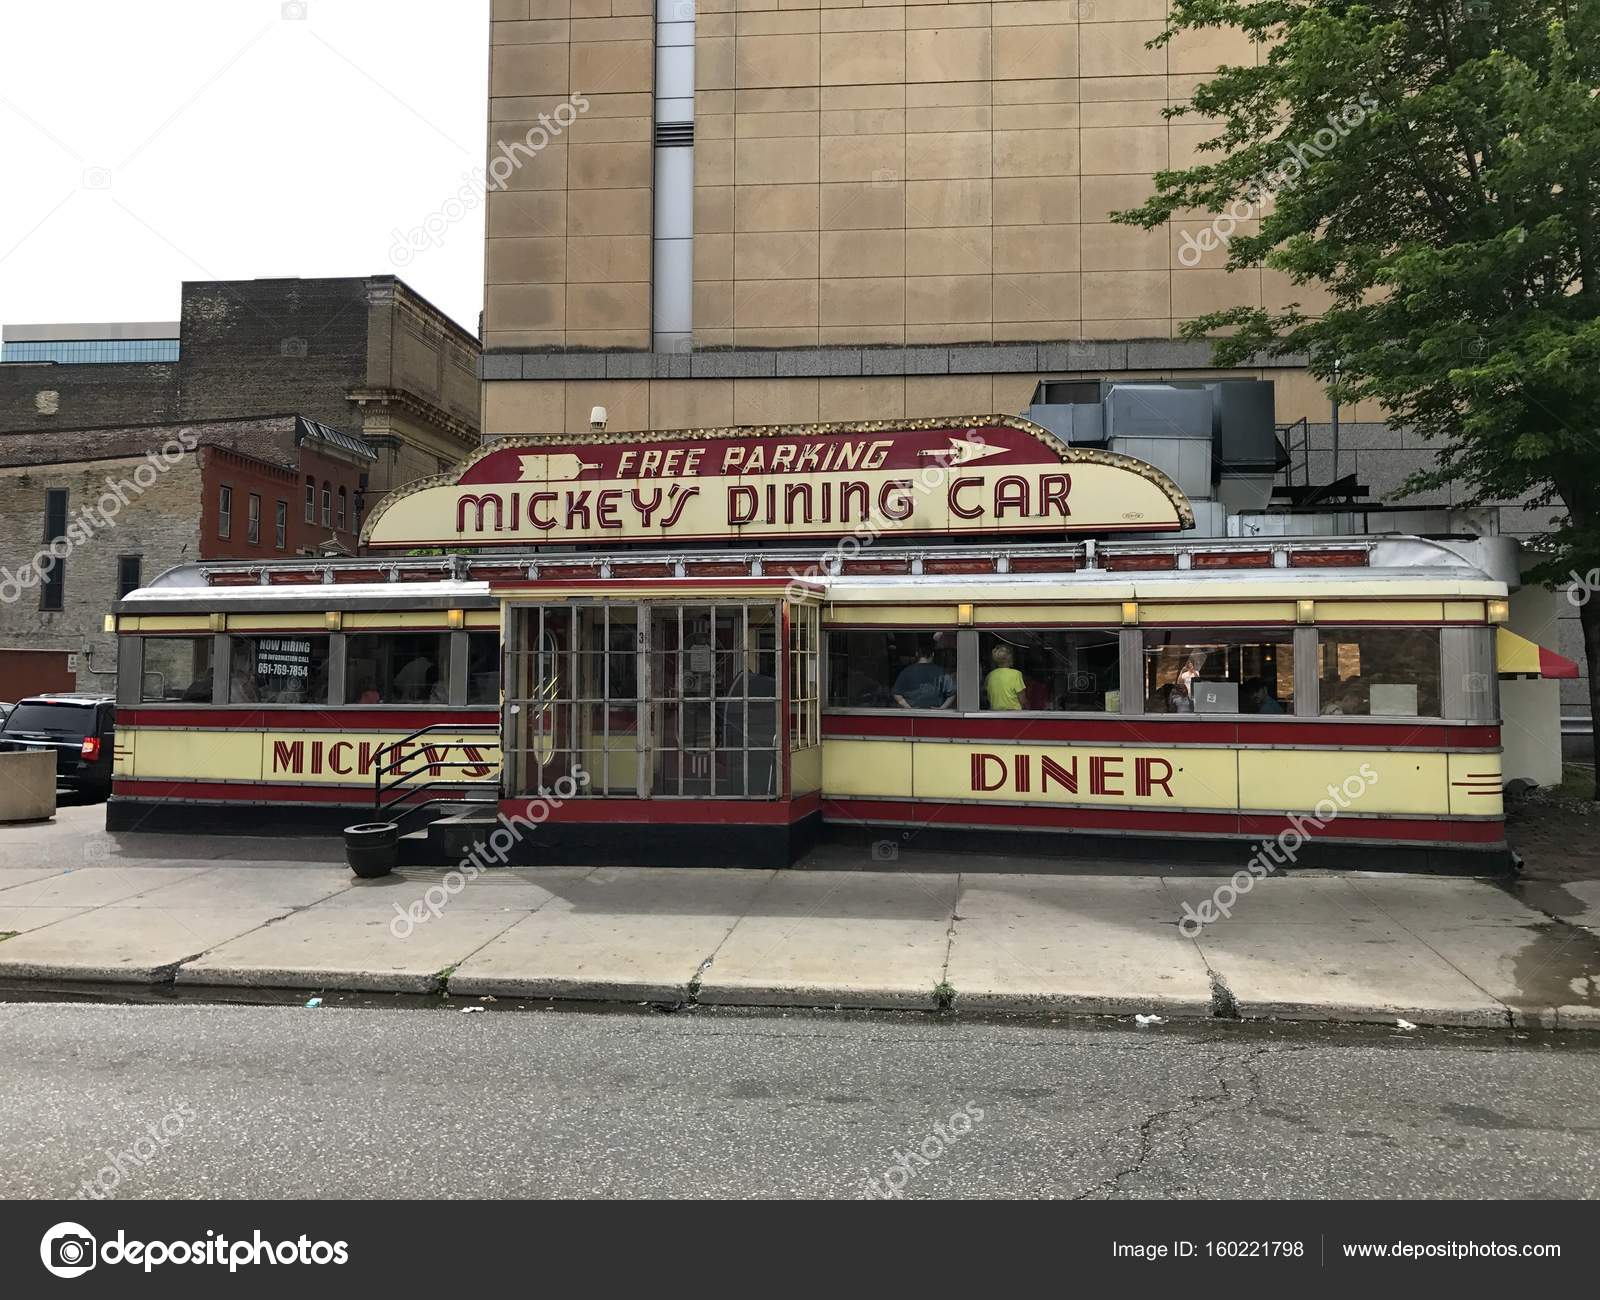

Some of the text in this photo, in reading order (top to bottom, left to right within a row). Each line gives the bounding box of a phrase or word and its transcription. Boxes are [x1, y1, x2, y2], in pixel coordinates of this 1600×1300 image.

[616, 440, 894, 479] FREE PARKING
[456, 473, 1072, 532] MICKEY'S DINING CAR
[260, 640, 310, 653] NOW HIRING
[273, 738, 491, 777] MICKEY'S
[971, 753, 1174, 797] DINER
